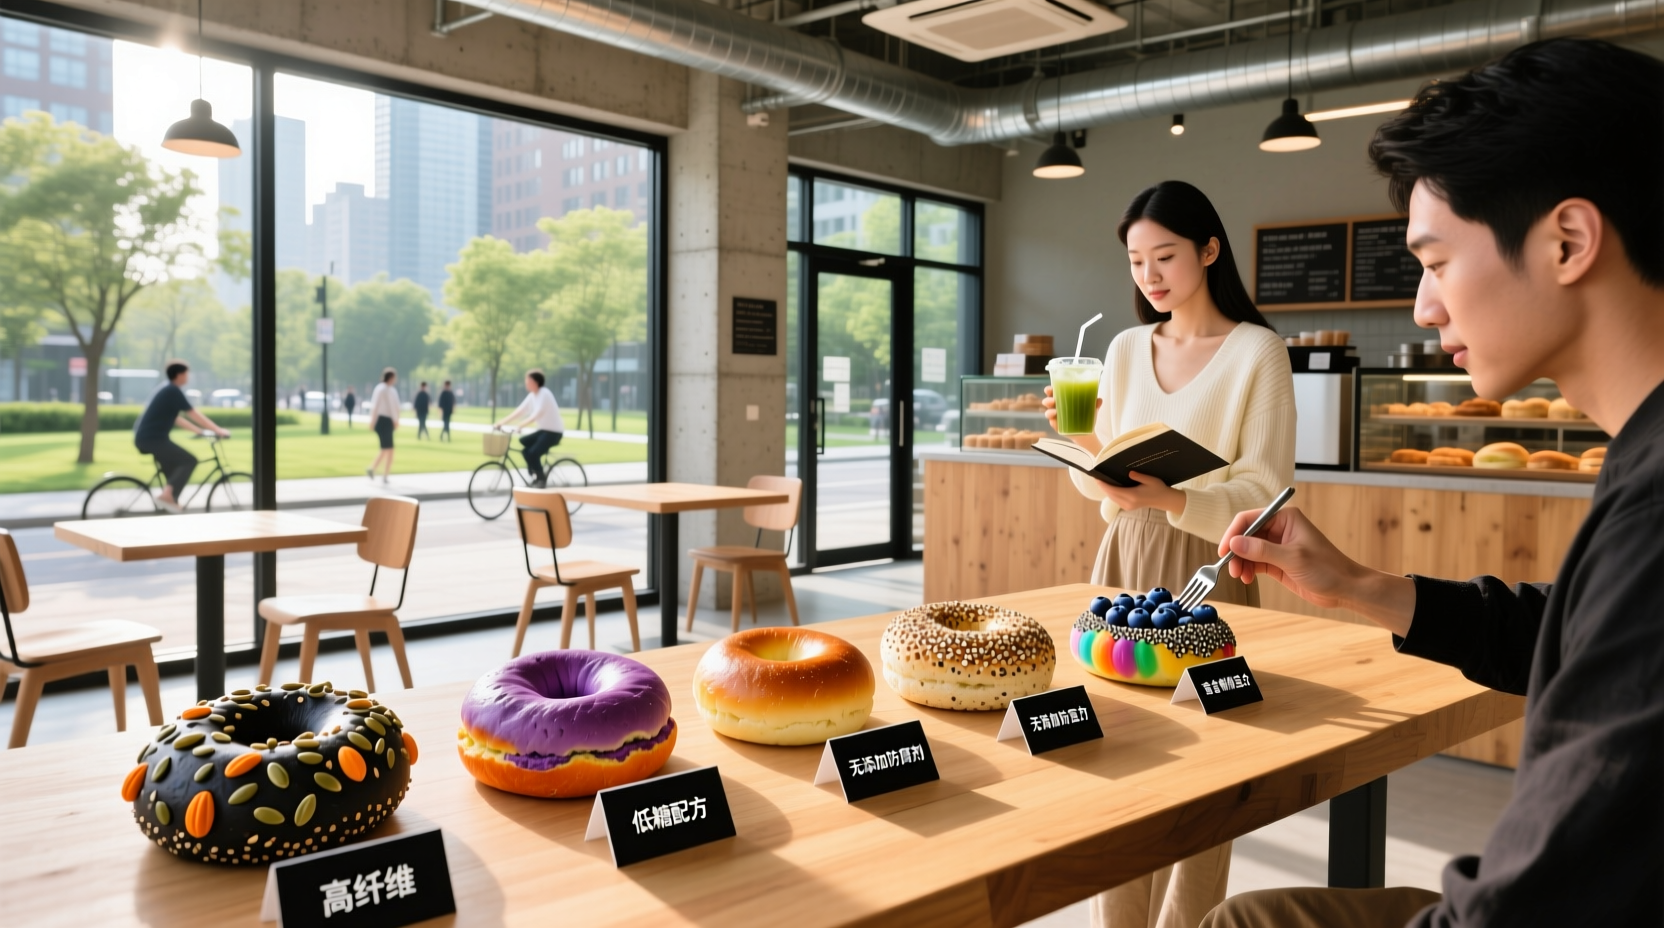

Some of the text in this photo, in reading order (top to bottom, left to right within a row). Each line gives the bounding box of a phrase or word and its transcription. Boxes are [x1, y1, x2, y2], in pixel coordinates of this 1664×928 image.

[631, 796, 707, 835] 低糖配方
[319, 863, 417, 918] 高纤维
